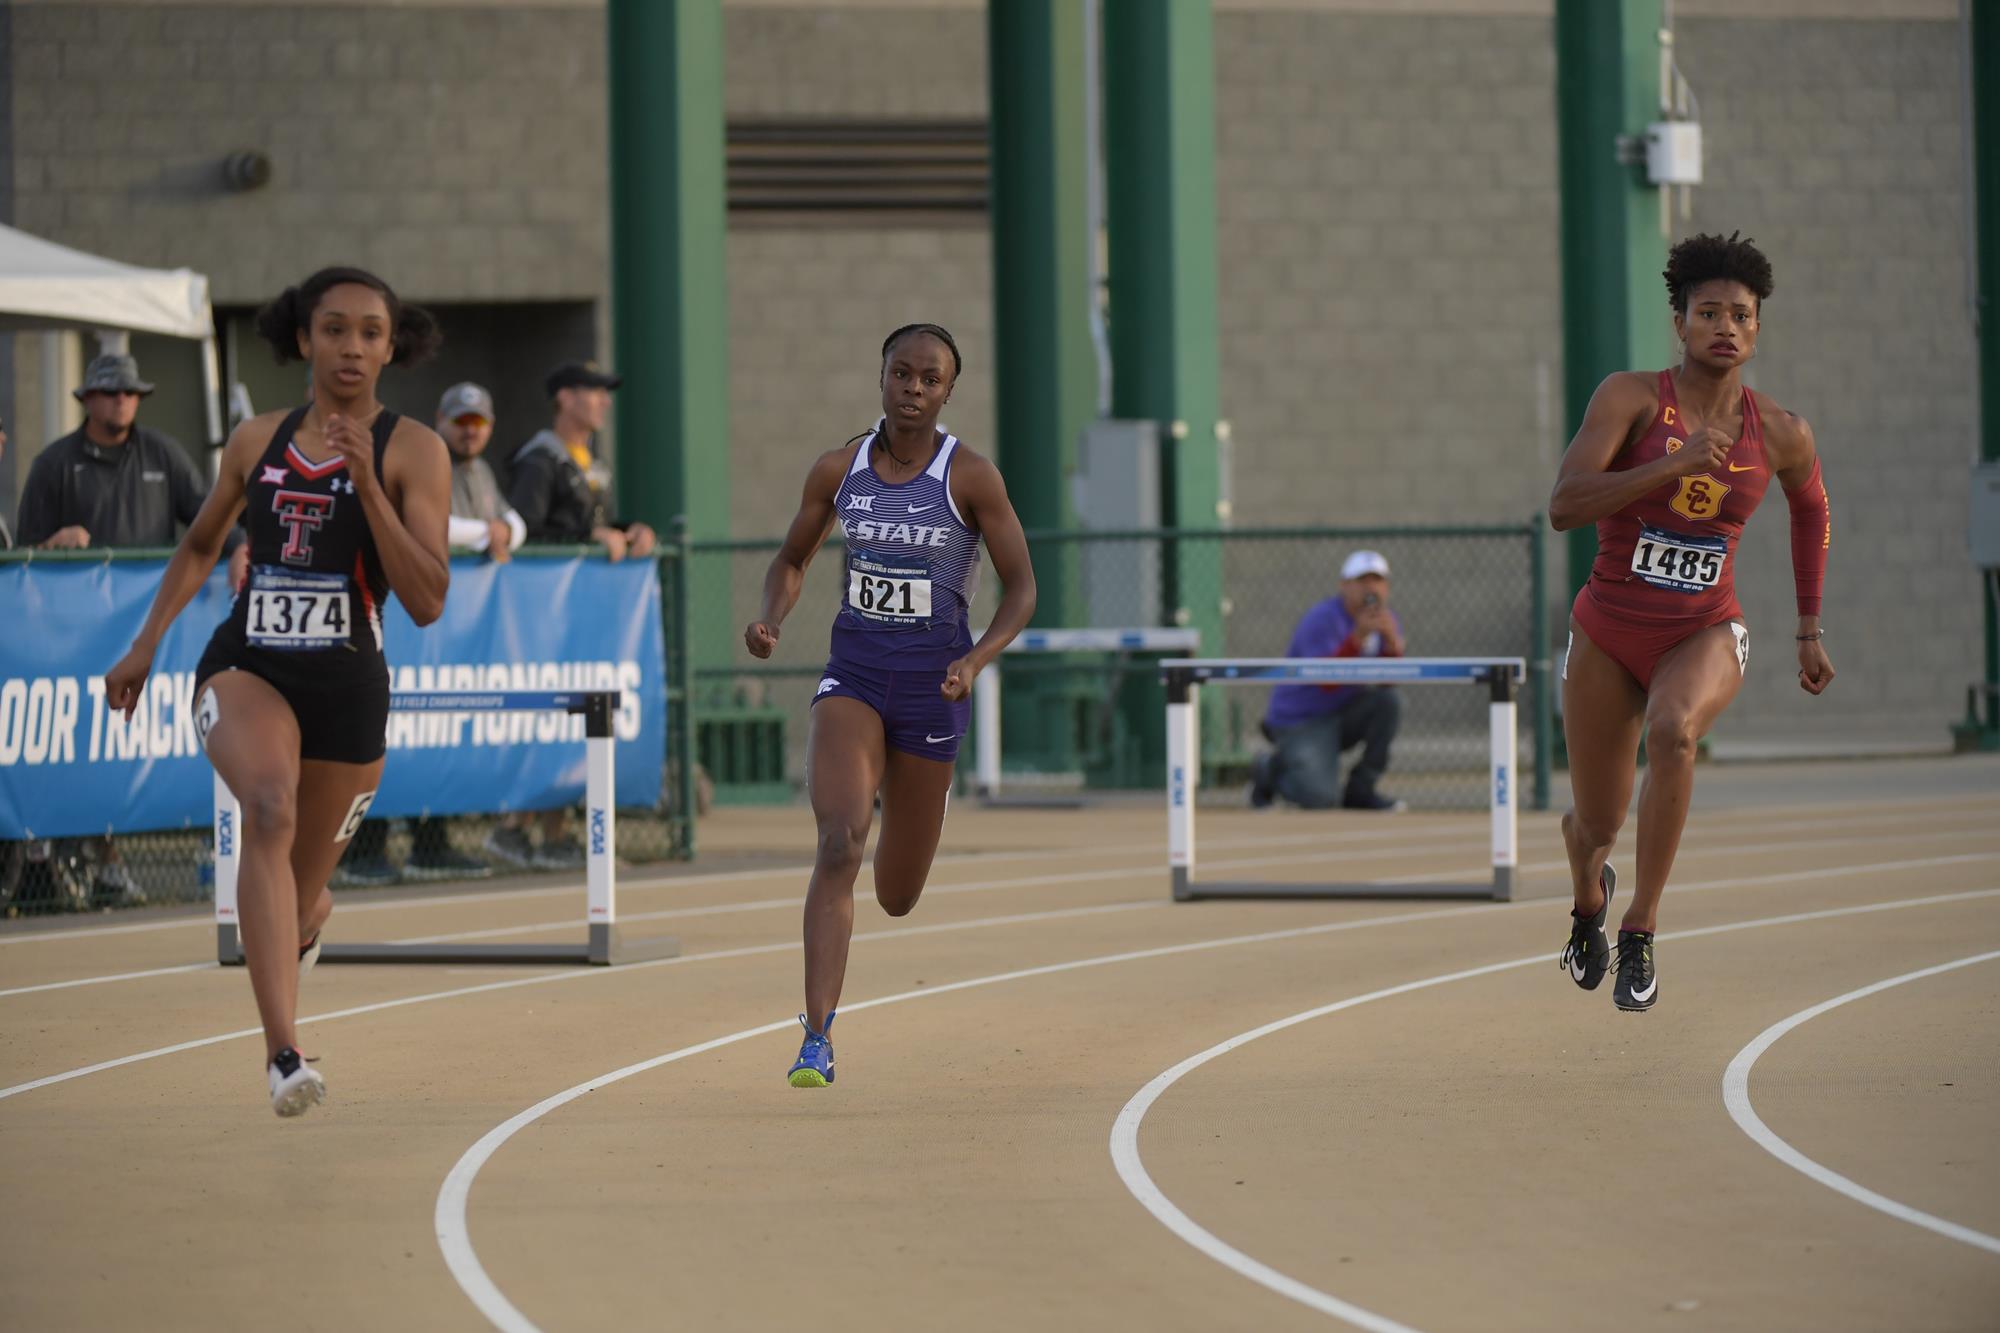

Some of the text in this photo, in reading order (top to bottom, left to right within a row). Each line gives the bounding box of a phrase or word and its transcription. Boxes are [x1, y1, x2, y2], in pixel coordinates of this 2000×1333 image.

[1664, 406, 1676, 425] C
[845, 493, 876, 512] XII
[1637, 542, 1722, 583] 1485
[253, 594, 346, 634] 1374
[860, 575, 915, 614] 621
[87, 671, 199, 763] TRACK
[385, 661, 641, 749] AMPIONSHIS
[428, 695, 504, 708] CHAMPIONSHIPS
[219, 809, 232, 856] NCAA
[592, 808, 605, 855] NCAA
